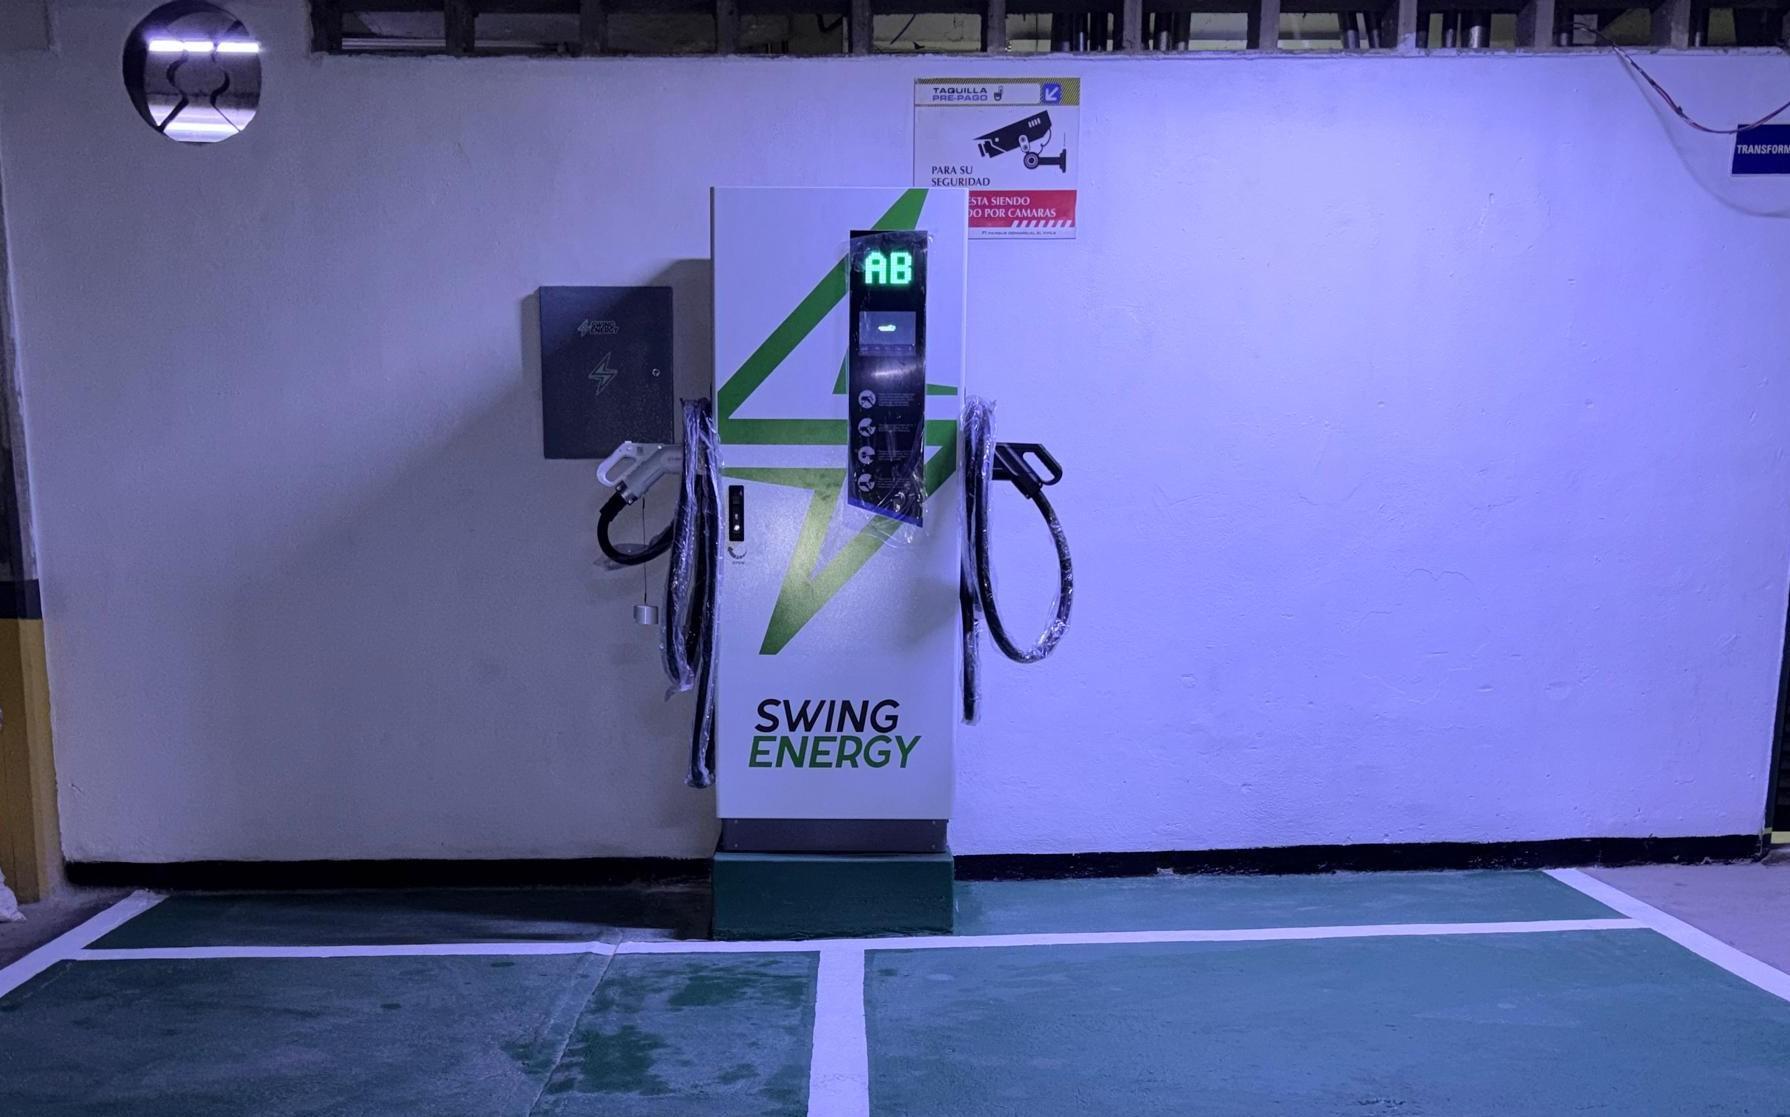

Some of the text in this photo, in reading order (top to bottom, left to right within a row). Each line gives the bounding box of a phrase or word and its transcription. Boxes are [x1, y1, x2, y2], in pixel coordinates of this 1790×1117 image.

[931, 165, 973, 175] PARA SU
[931, 177, 991, 186] SEGURIDAD
[991, 196, 1031, 206] SIENDO
[984, 208, 1006, 218] POR
[1008, 208, 1057, 218] CAMARAS
[865, 251, 912, 284] AB
[754, 698, 900, 734] SWING
[748, 734, 922, 769] ENERGY
